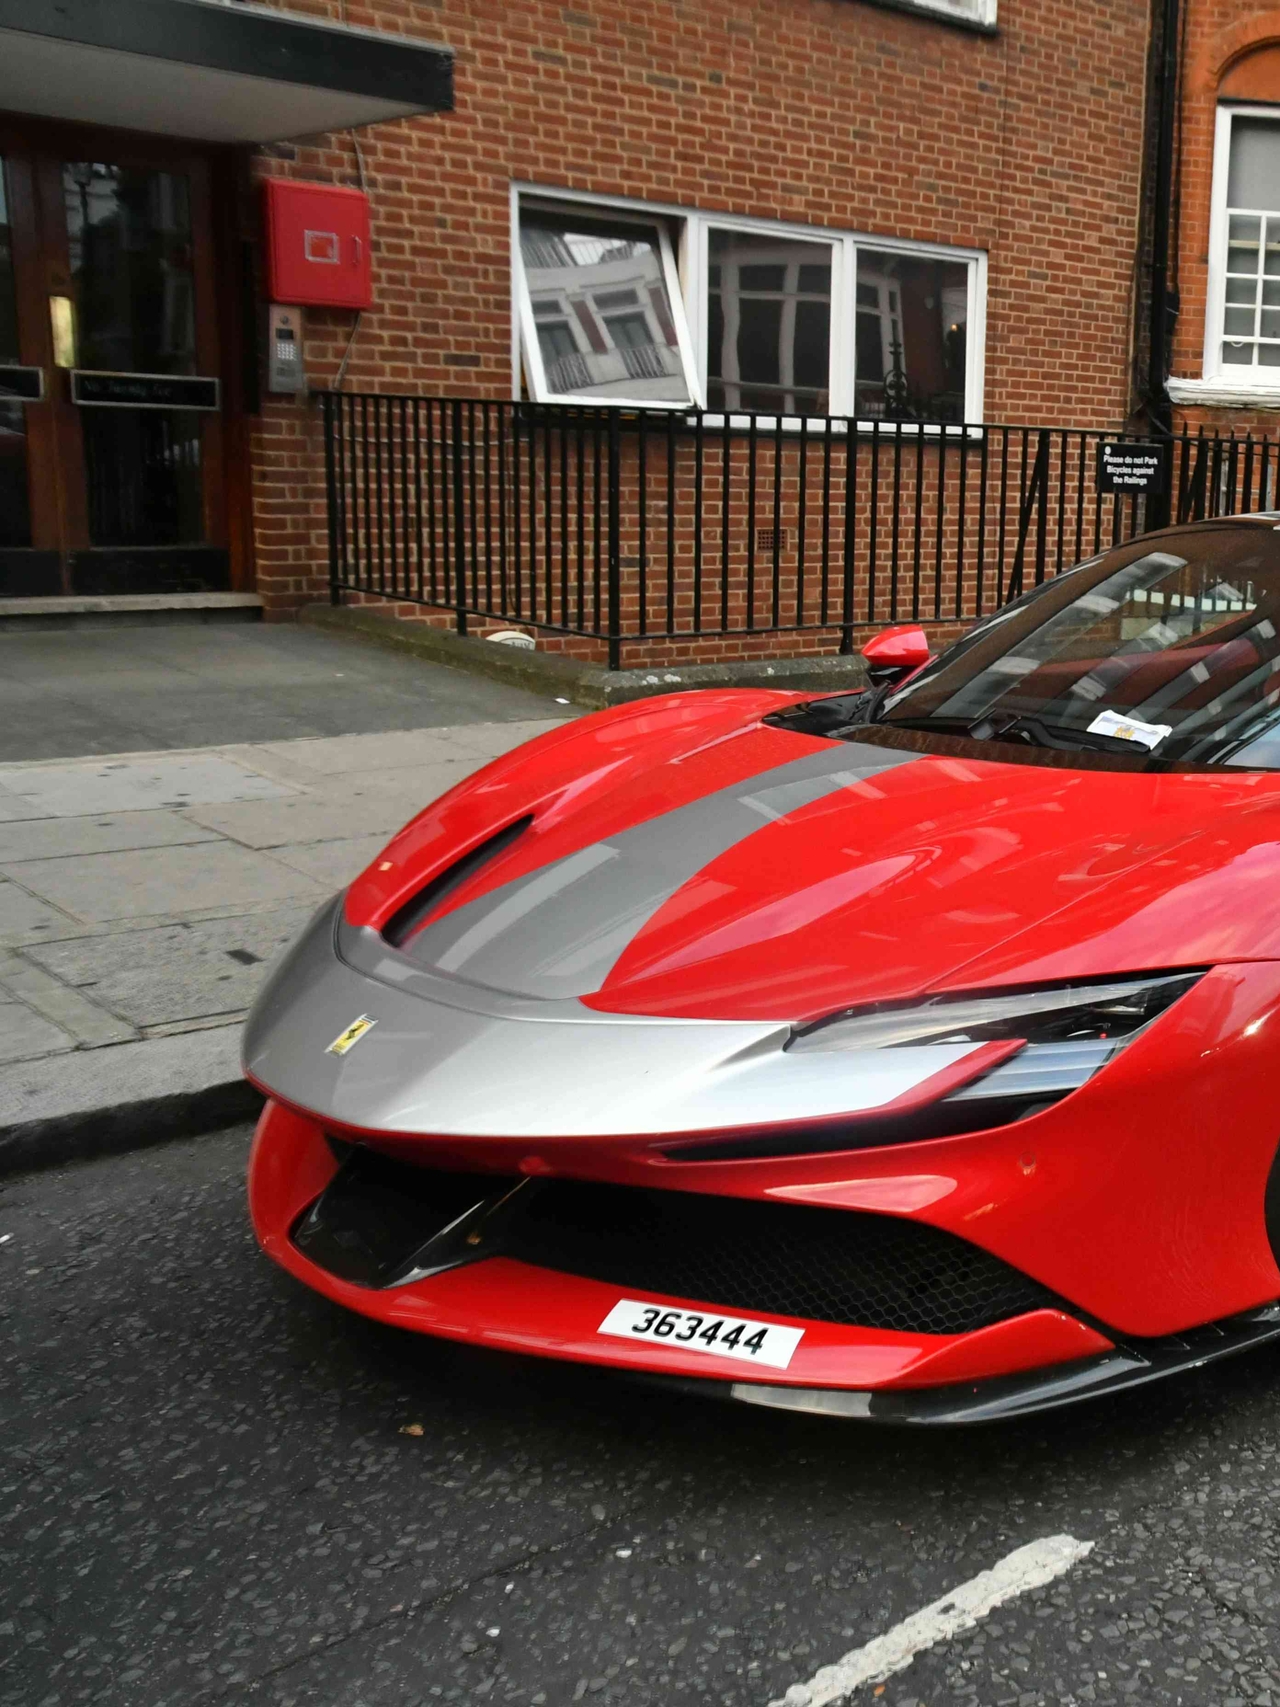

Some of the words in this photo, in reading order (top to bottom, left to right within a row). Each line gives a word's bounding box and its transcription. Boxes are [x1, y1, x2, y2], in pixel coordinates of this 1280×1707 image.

[1103, 454, 1124, 463] Please
[1124, 455, 1133, 464] do
[1133, 456, 1144, 465] not
[1144, 456, 1158, 465] Park
[1106, 465, 1132, 475] Bicycles
[1132, 466, 1154, 476] against
[1112, 475, 1123, 484] the
[1123, 475, 1148, 486] Railings
[631, 1308, 769, 1356] 363444
